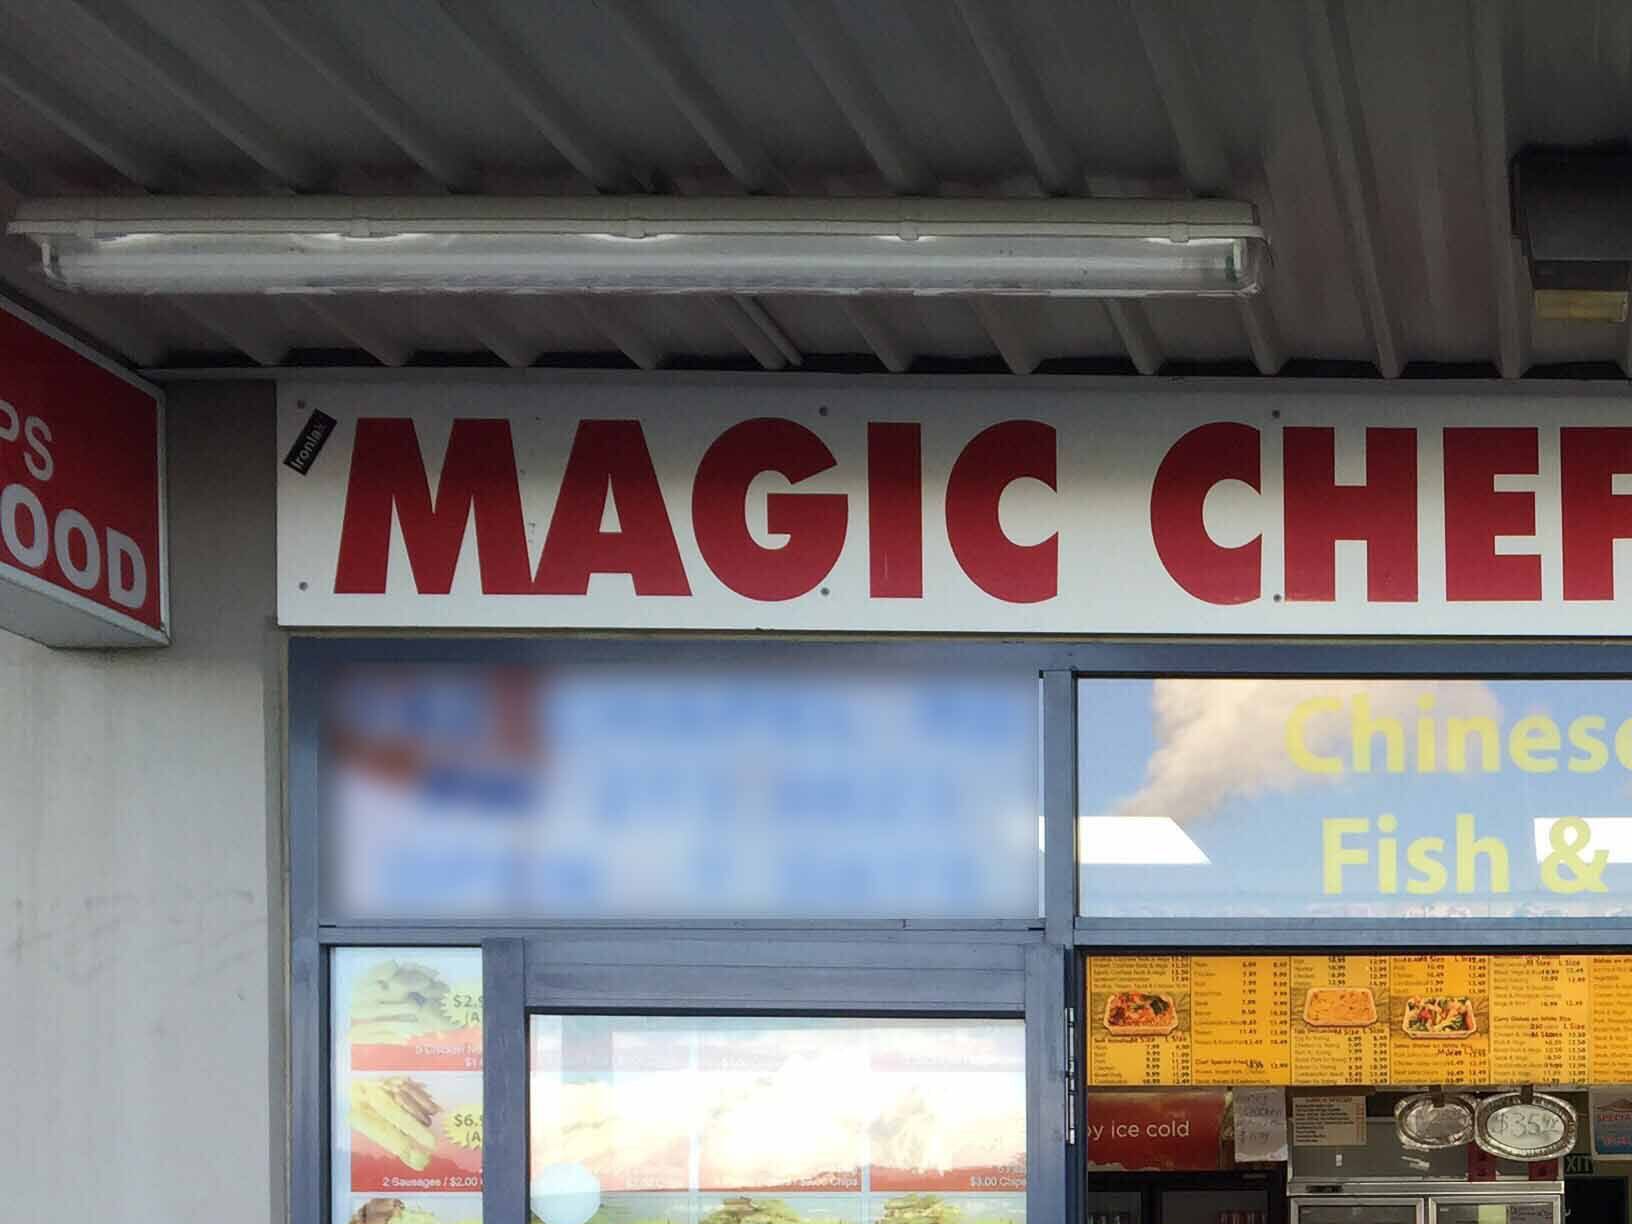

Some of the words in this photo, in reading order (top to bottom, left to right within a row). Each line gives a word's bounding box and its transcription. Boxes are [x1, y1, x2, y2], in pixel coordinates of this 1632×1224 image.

[334, 418, 1058, 601] MAGIC
[1322, 814, 1508, 894] Fish
[1541, 816, 1609, 895] &
[1111, 1120, 1139, 1138] ice
[1146, 1120, 1190, 1137] cold
